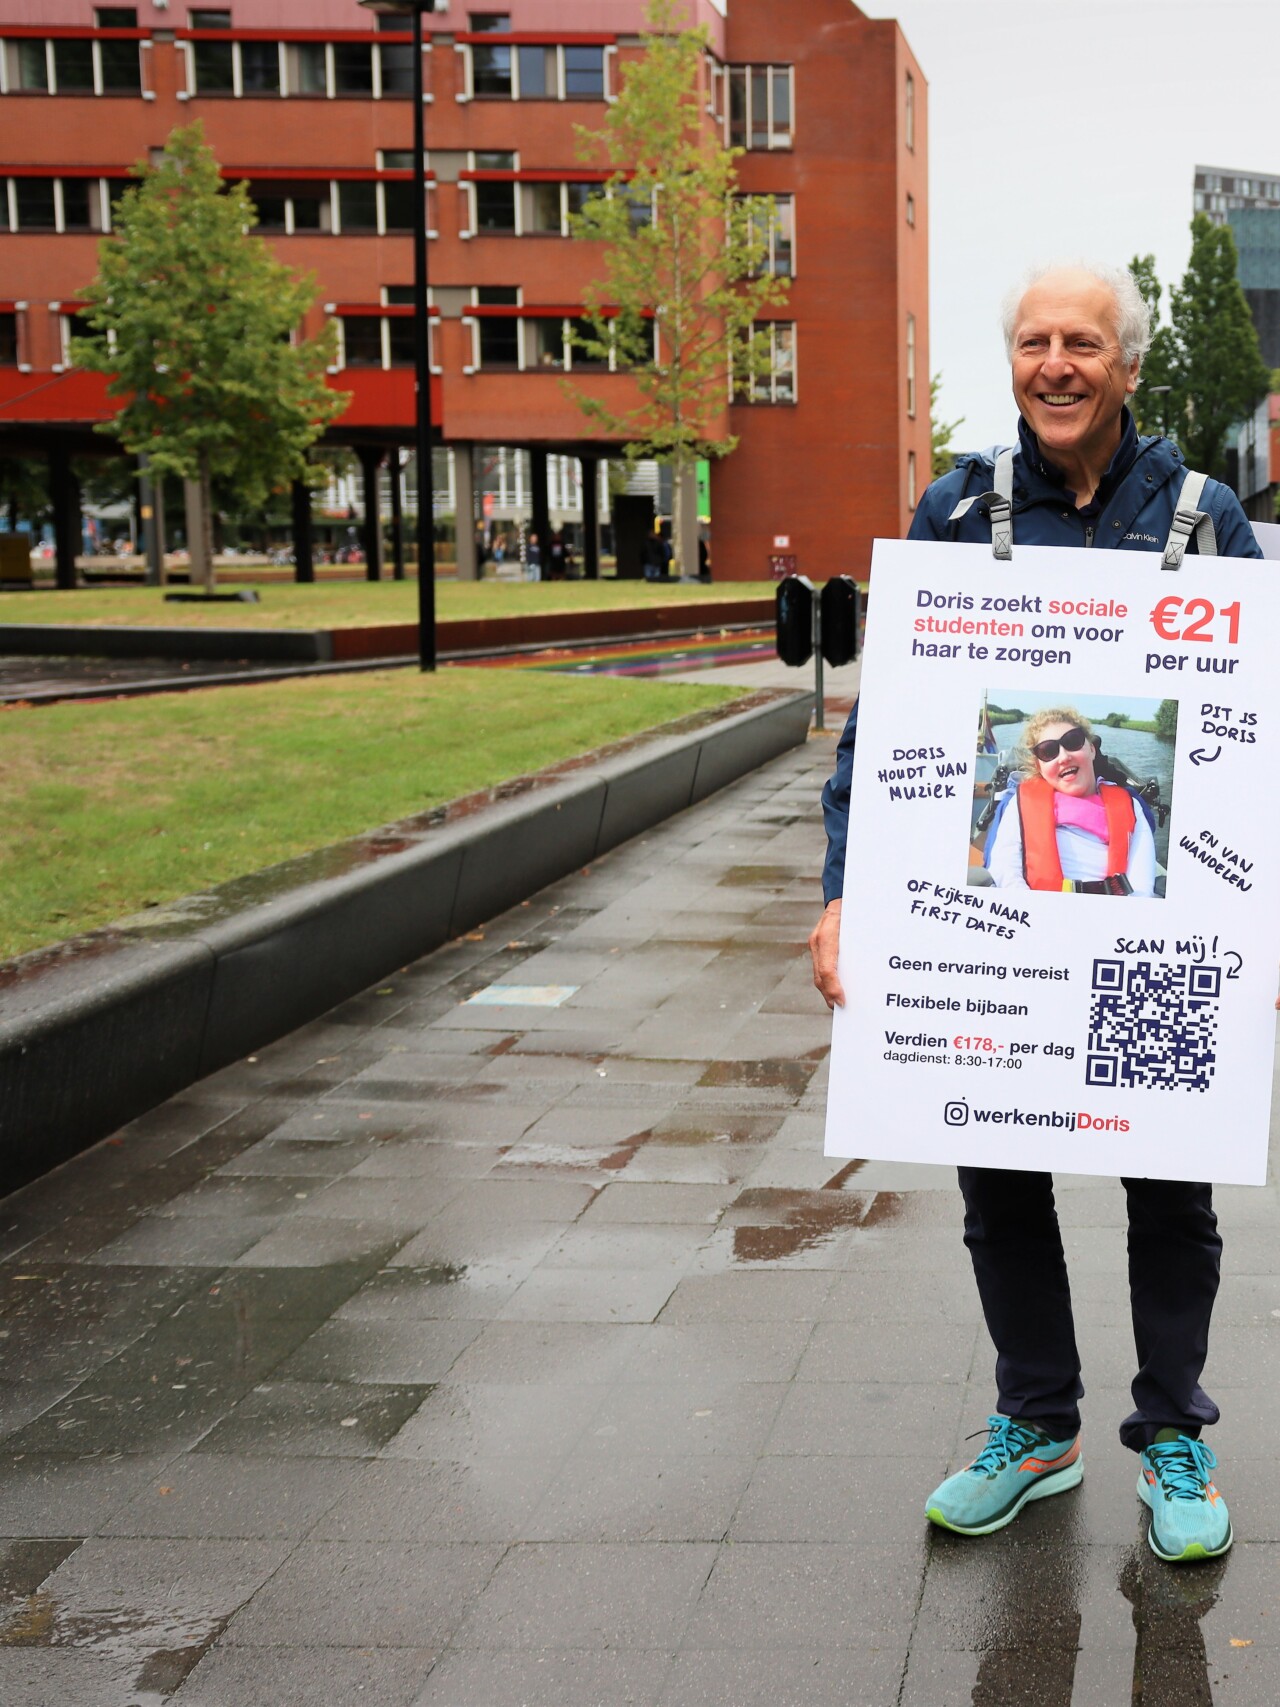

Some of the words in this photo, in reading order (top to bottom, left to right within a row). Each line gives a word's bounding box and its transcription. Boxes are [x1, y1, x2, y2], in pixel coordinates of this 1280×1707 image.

[1143, 533, 1159, 544] Klein
[916, 589, 974, 610] Doris
[980, 594, 1043, 614] zoekt
[1048, 598, 1128, 618] sociale
[914, 615, 1024, 637] studenten
[1031, 624, 1066, 639] om
[1073, 626, 1125, 643] voor
[1149, 595, 1241, 644] €21
[911, 638, 962, 659] haar
[967, 642, 989, 660] te
[994, 647, 1071, 667] zorgen
[1145, 653, 1189, 674] per
[1196, 656, 1240, 675] uur
[1201, 703, 1233, 722] DIT
[1238, 712, 1258, 726] IS
[1202, 721, 1257, 743] DORIS
[892, 746, 946, 762] DORIS
[877, 765, 927, 783] HOUDT
[935, 761, 968, 778] VAN
[1179, 835, 1253, 892] WANDELEN
[1199, 830, 1219, 848] EN
[1221, 846, 1254, 873] VAN
[907, 879, 932, 892] OF
[989, 902, 1031, 928] NAAR
[910, 899, 962, 925] FIRST
[965, 916, 1016, 940] DATES
[1113, 937, 1165, 955] SCAN
[888, 955, 933, 972] Geen
[937, 961, 1007, 980] ervaring
[1012, 966, 1070, 981] vereist
[886, 993, 961, 1012] Flexibele
[966, 998, 1029, 1016] bijbaan
[884, 1030, 948, 1049] Verdien
[953, 1035, 1005, 1054] €178,-
[1009, 1042, 1039, 1056] per
[1042, 1041, 1075, 1060] dag
[883, 1049, 951, 1065] dagdienst:
[954, 1054, 1023, 1070] 8:30-17:00
[973, 1108, 1130, 1133] werkenbijDoris
